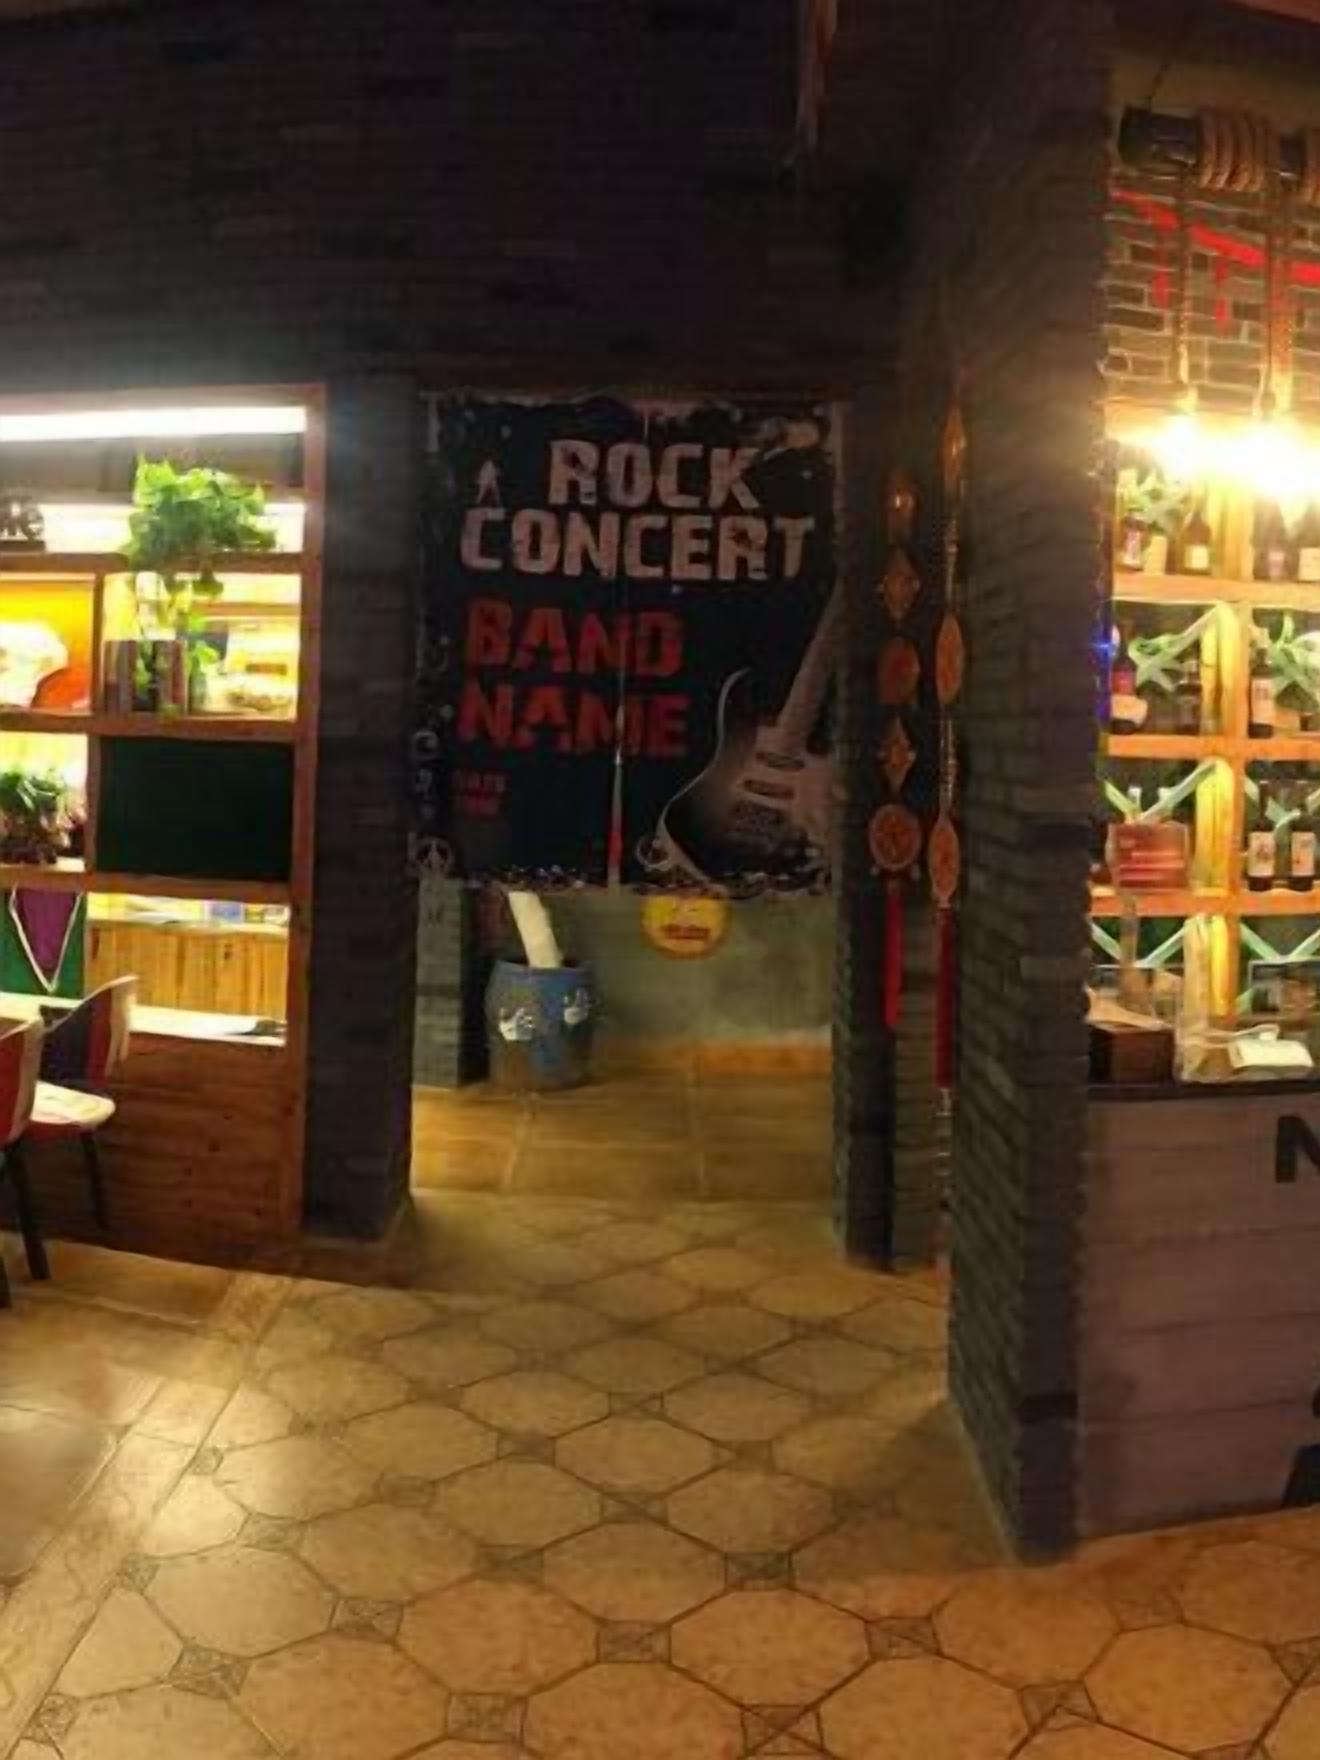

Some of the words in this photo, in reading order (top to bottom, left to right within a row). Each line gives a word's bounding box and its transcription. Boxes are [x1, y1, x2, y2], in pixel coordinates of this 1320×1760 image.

[548, 438, 761, 509] ROCK
[459, 507, 817, 581] CONCERT
[465, 597, 685, 677] BAND
[456, 676, 691, 757] NAME
